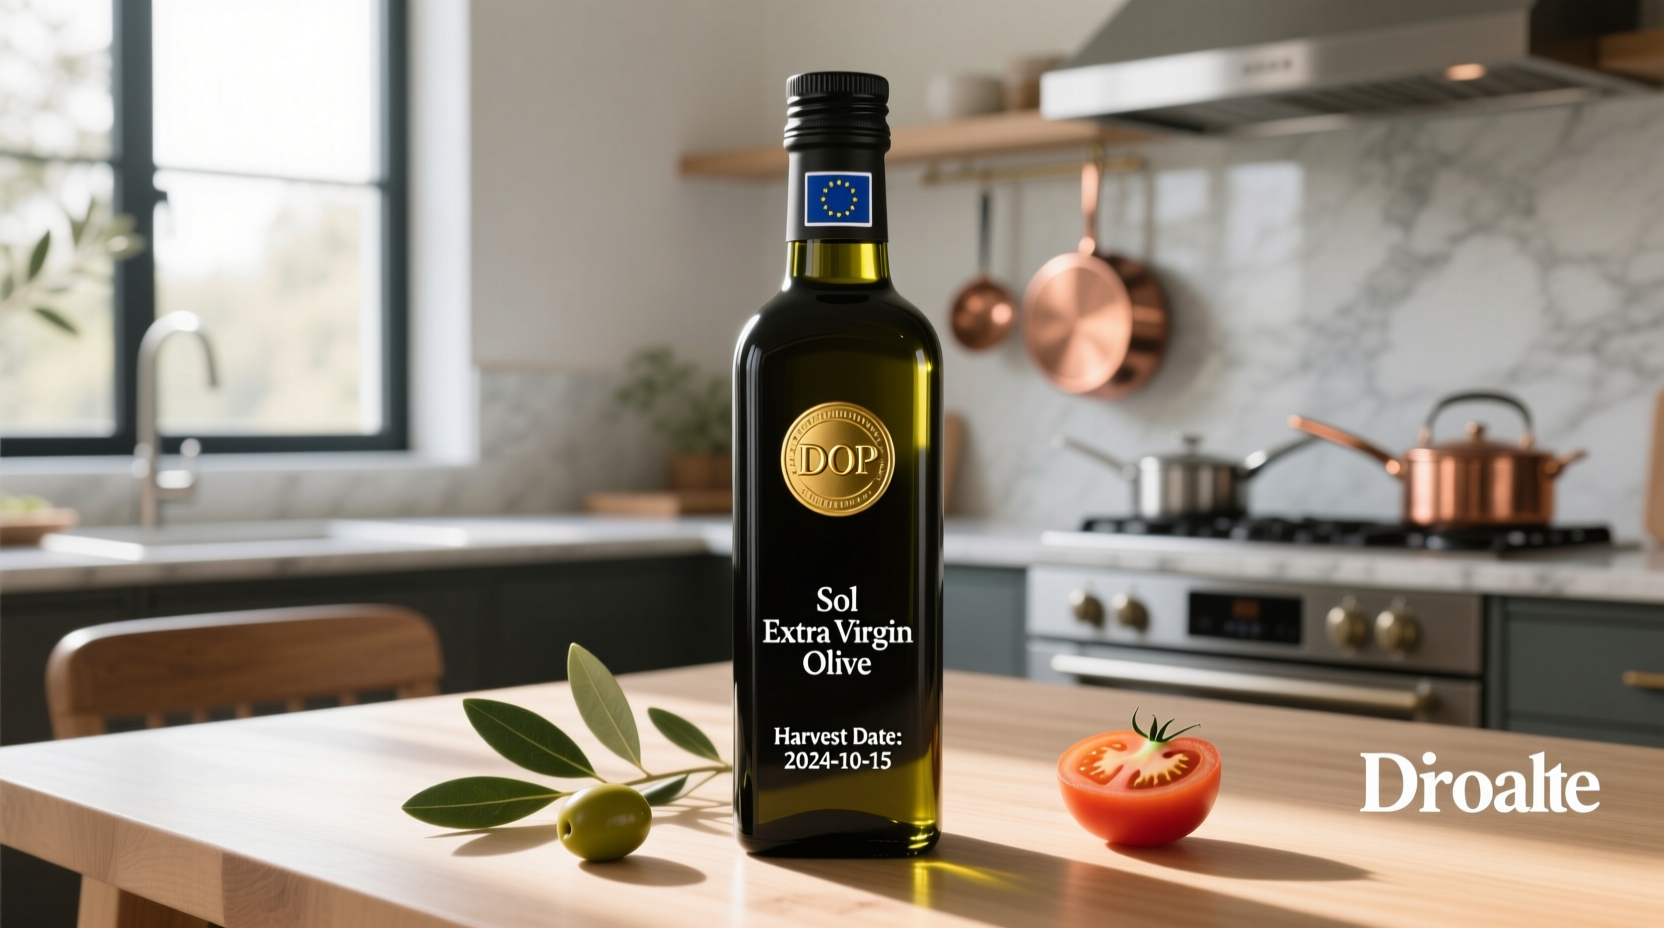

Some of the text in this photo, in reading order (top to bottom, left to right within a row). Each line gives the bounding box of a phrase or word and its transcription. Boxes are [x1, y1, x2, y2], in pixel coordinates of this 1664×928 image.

[798, 444, 878, 476] DOP
[816, 585, 859, 613] Sol
[762, 618, 914, 651] Extra Virgin
[802, 649, 872, 676] Olive
[773, 726, 903, 746] Harvest Date:
[784, 750, 892, 770] 2024-10-15
